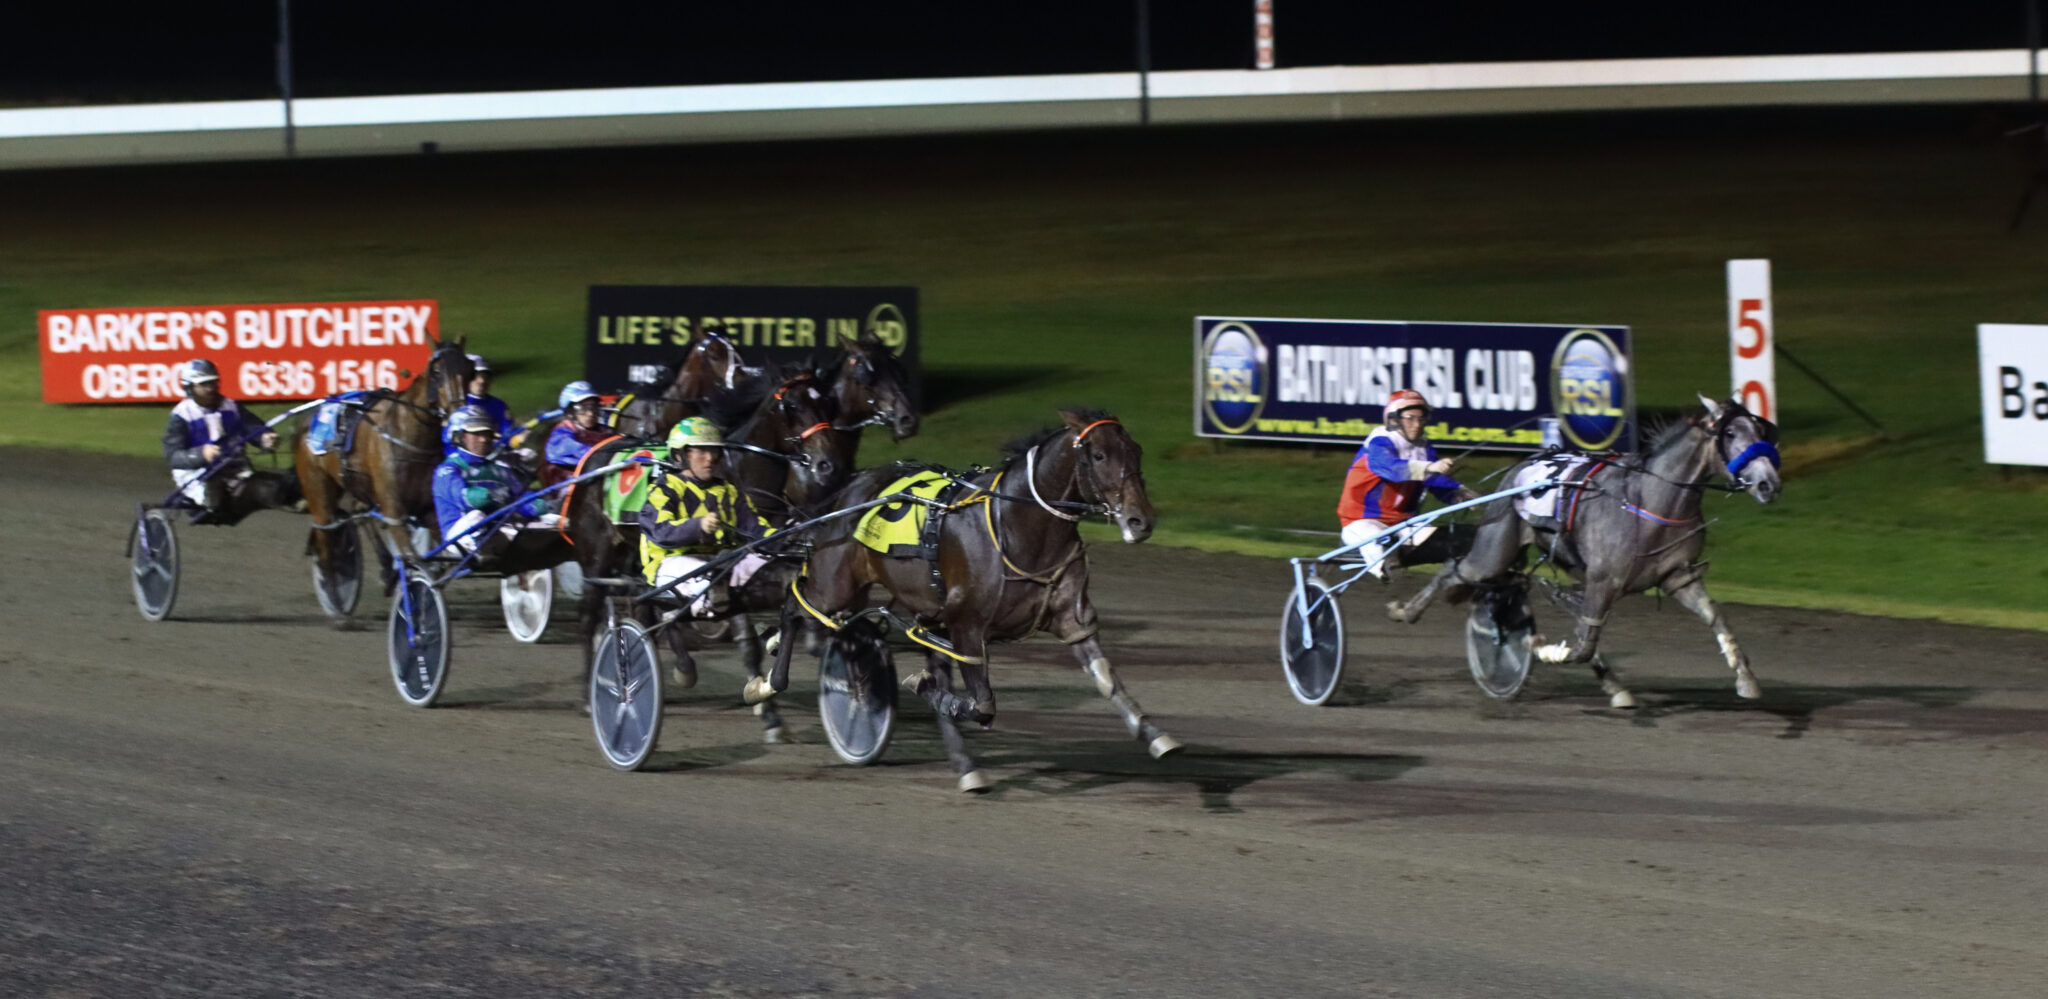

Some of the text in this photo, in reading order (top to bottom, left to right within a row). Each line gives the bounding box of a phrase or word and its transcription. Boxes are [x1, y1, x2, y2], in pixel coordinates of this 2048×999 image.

[48, 306, 431, 353] BARKER'S BUTCHERY
[598, 316, 690, 346] LIFE'S
[826, 318, 858, 347] IN
[239, 360, 315, 397] 6336
[320, 359, 399, 395] 1516
[1206, 367, 1262, 402] RSL
[1277, 344, 1537, 412] BATHURST RSL CLUB
[1559, 378, 1625, 416] RSL
